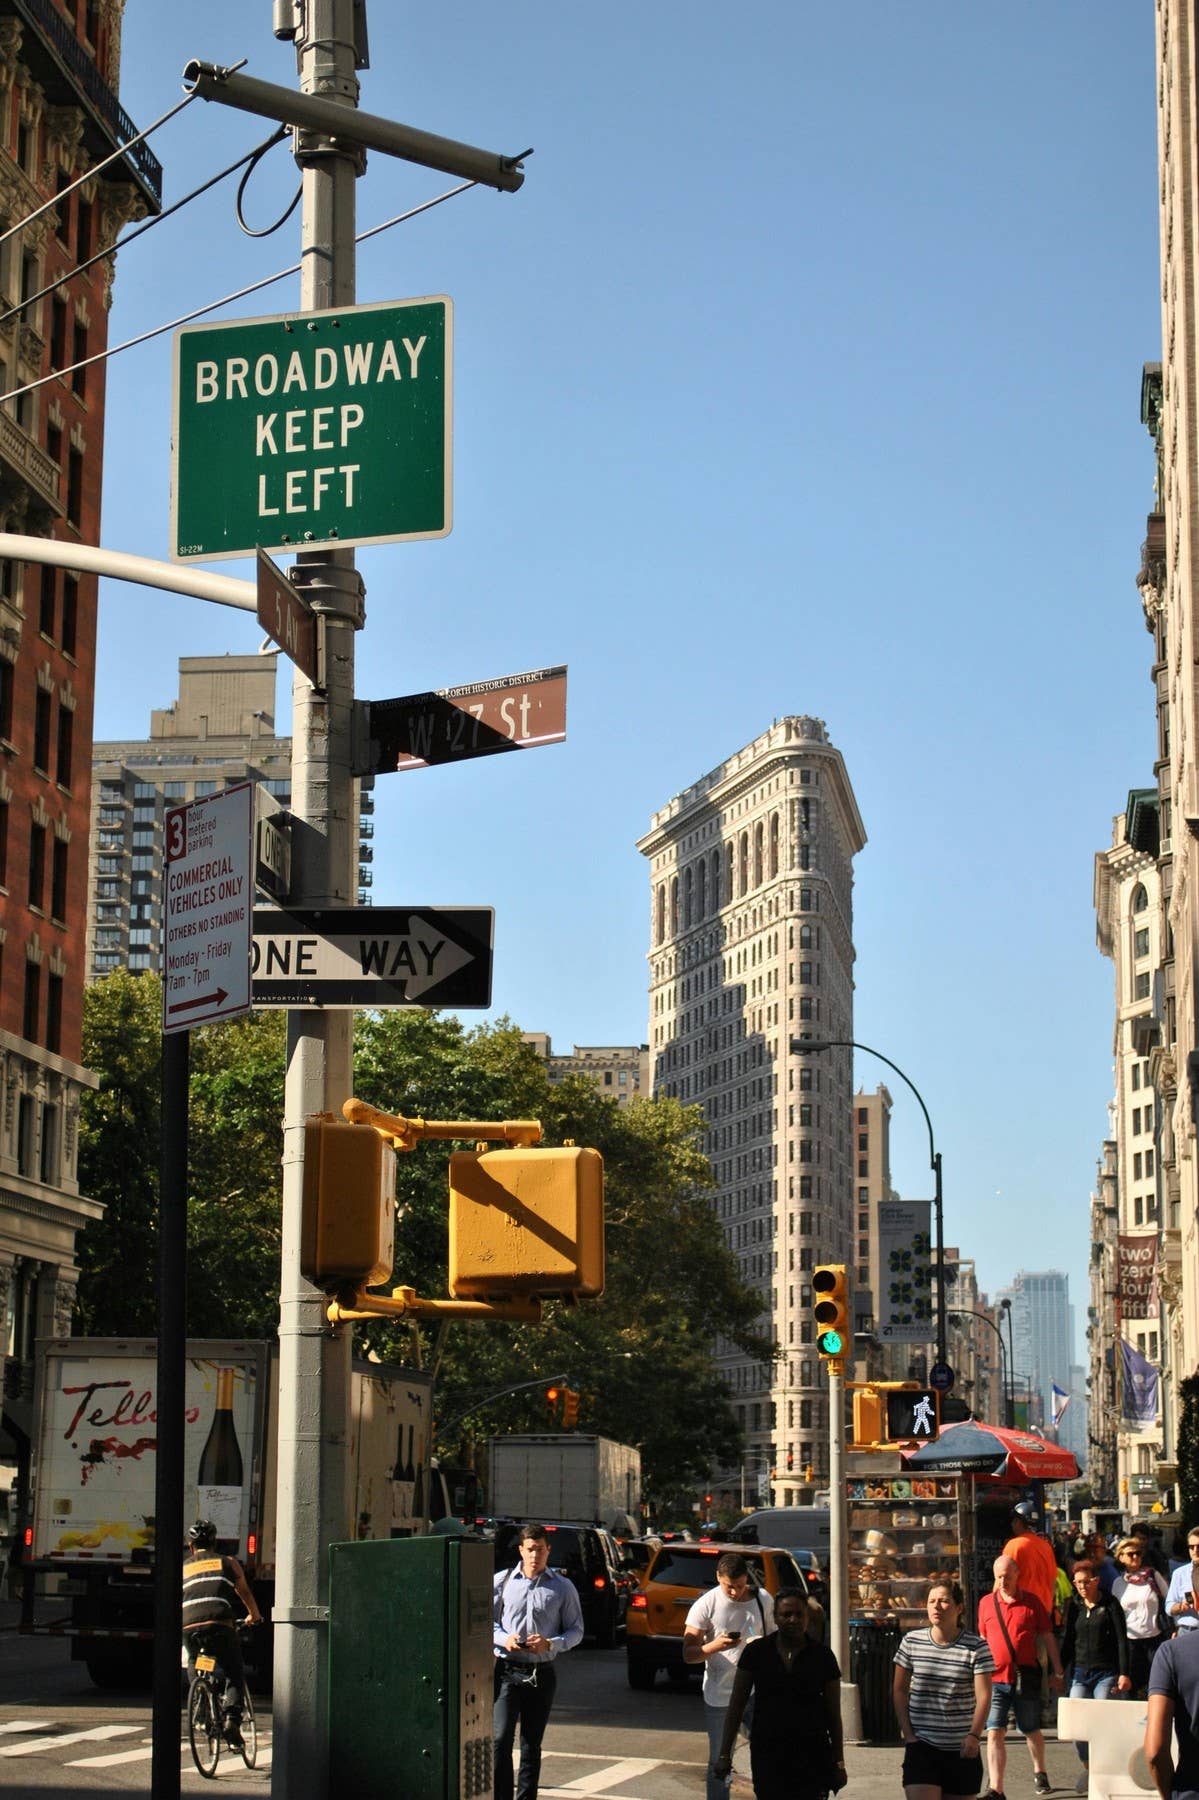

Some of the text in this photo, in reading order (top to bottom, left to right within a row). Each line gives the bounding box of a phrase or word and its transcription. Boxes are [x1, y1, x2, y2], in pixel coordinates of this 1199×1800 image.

[196, 335, 427, 403] BROADWAY
[256, 404, 364, 457] KEEP
[258, 464, 360, 516] LEFT
[276, 591, 282, 637] 5
[472, 679, 507, 694] HISTORIC
[509, 671, 544, 686] DISTRICT
[450, 703, 484, 752] 27
[500, 694, 531, 740] St
[170, 814, 183, 856] 3
[188, 815, 217, 838] metered
[188, 834, 213, 855] parking
[170, 855, 234, 892] COMMERCIAL
[169, 885, 216, 915] VEHICLES
[219, 876, 244, 900] ONLY
[169, 907, 245, 942] OTHERS NO STANDING
[169, 950, 200, 971] Monday
[207, 941, 232, 960] Friday
[359, 940, 447, 976] WAY
[169, 975, 186, 991] 7am
[193, 968, 210, 987] 7pm
[1120, 1244, 1152, 1261] two
[1120, 1264, 1154, 1278] zero
[1121, 1279, 1154, 1296] four
[1122, 1299, 1157, 1318] fifth
